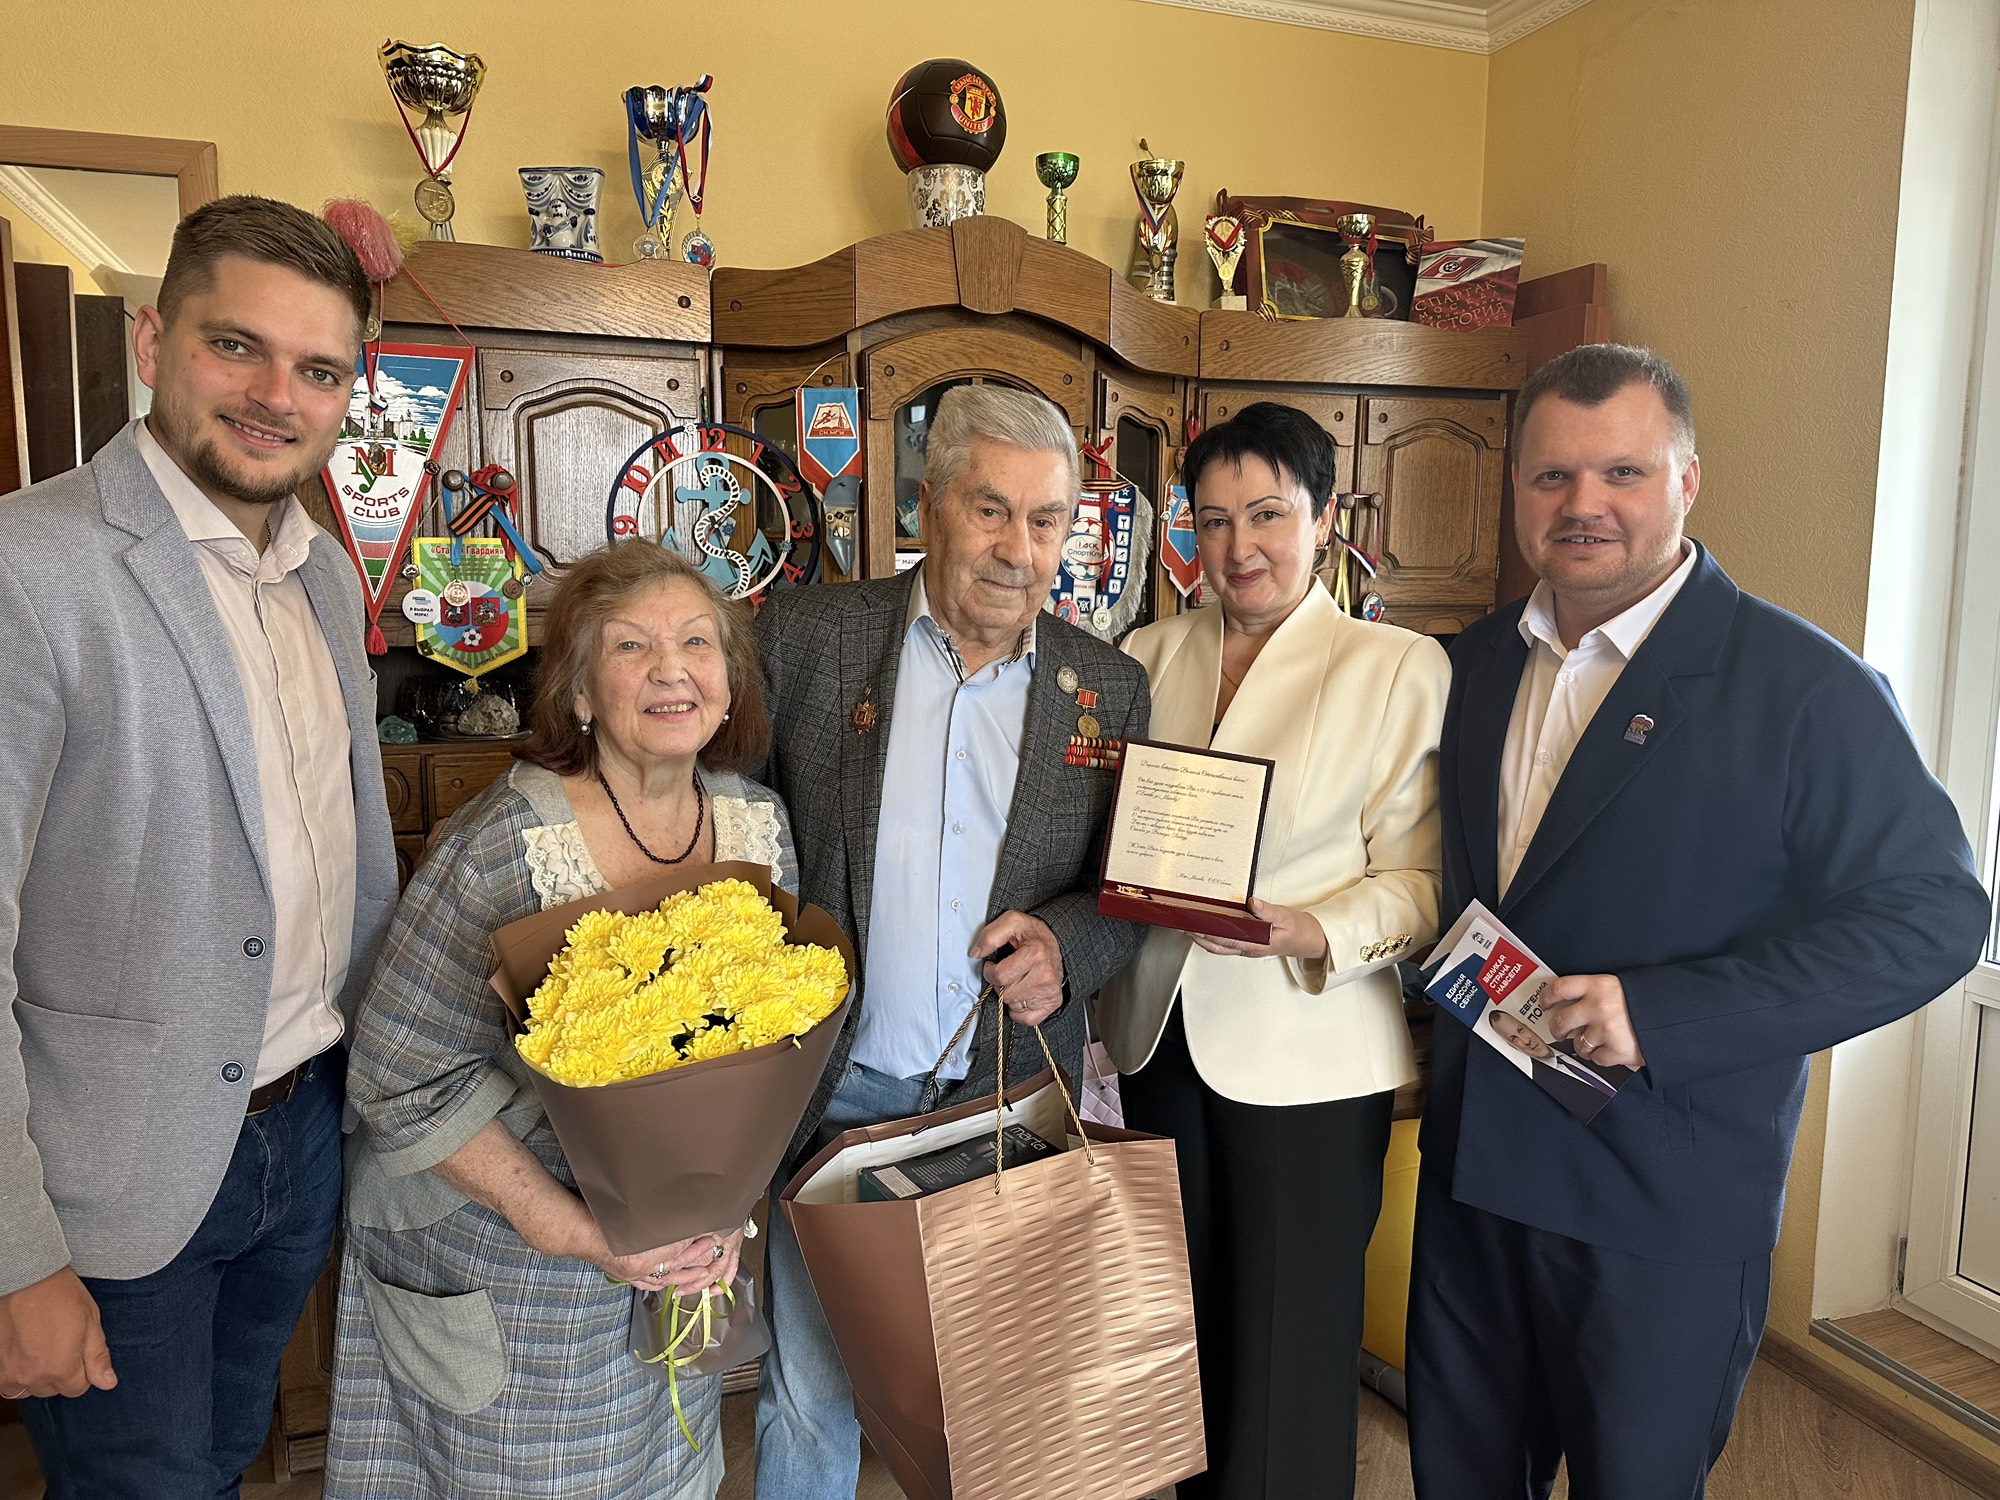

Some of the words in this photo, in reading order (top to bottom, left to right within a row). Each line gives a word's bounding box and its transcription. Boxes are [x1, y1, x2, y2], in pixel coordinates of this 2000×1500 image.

[954, 77, 994, 103] MANCHESTER
[958, 114, 987, 130] UNITED
[1415, 280, 1495, 311] СПАРТАК
[1419, 290, 1500, 320] МОСКВА
[1429, 301, 1507, 331] СТОРИЯ
[652, 436, 683, 464] 11
[697, 428, 726, 452] 12
[750, 442, 764, 464] 1
[621, 465, 651, 497] 10
[775, 475, 801, 499] 2
[342, 484, 410, 507] SPORTS
[353, 506, 400, 518] CLUB
[613, 515, 638, 535] 9
[790, 520, 814, 539] 3
[783, 561, 805, 584] 4
[1482, 954, 1507, 984] ВЕЛИКАЯ
[1489, 964, 1511, 989] СТРАНА
[1495, 962, 1523, 995] НАВСЕГДА
[1445, 973, 1467, 1000] ЕДИНАЯ
[1452, 978, 1473, 1005] РОССИЯ
[1459, 985, 1478, 1009] СЕЙЧАС
[1527, 1004, 1546, 1025] ПО
[1010, 1127, 1047, 1151] marta
